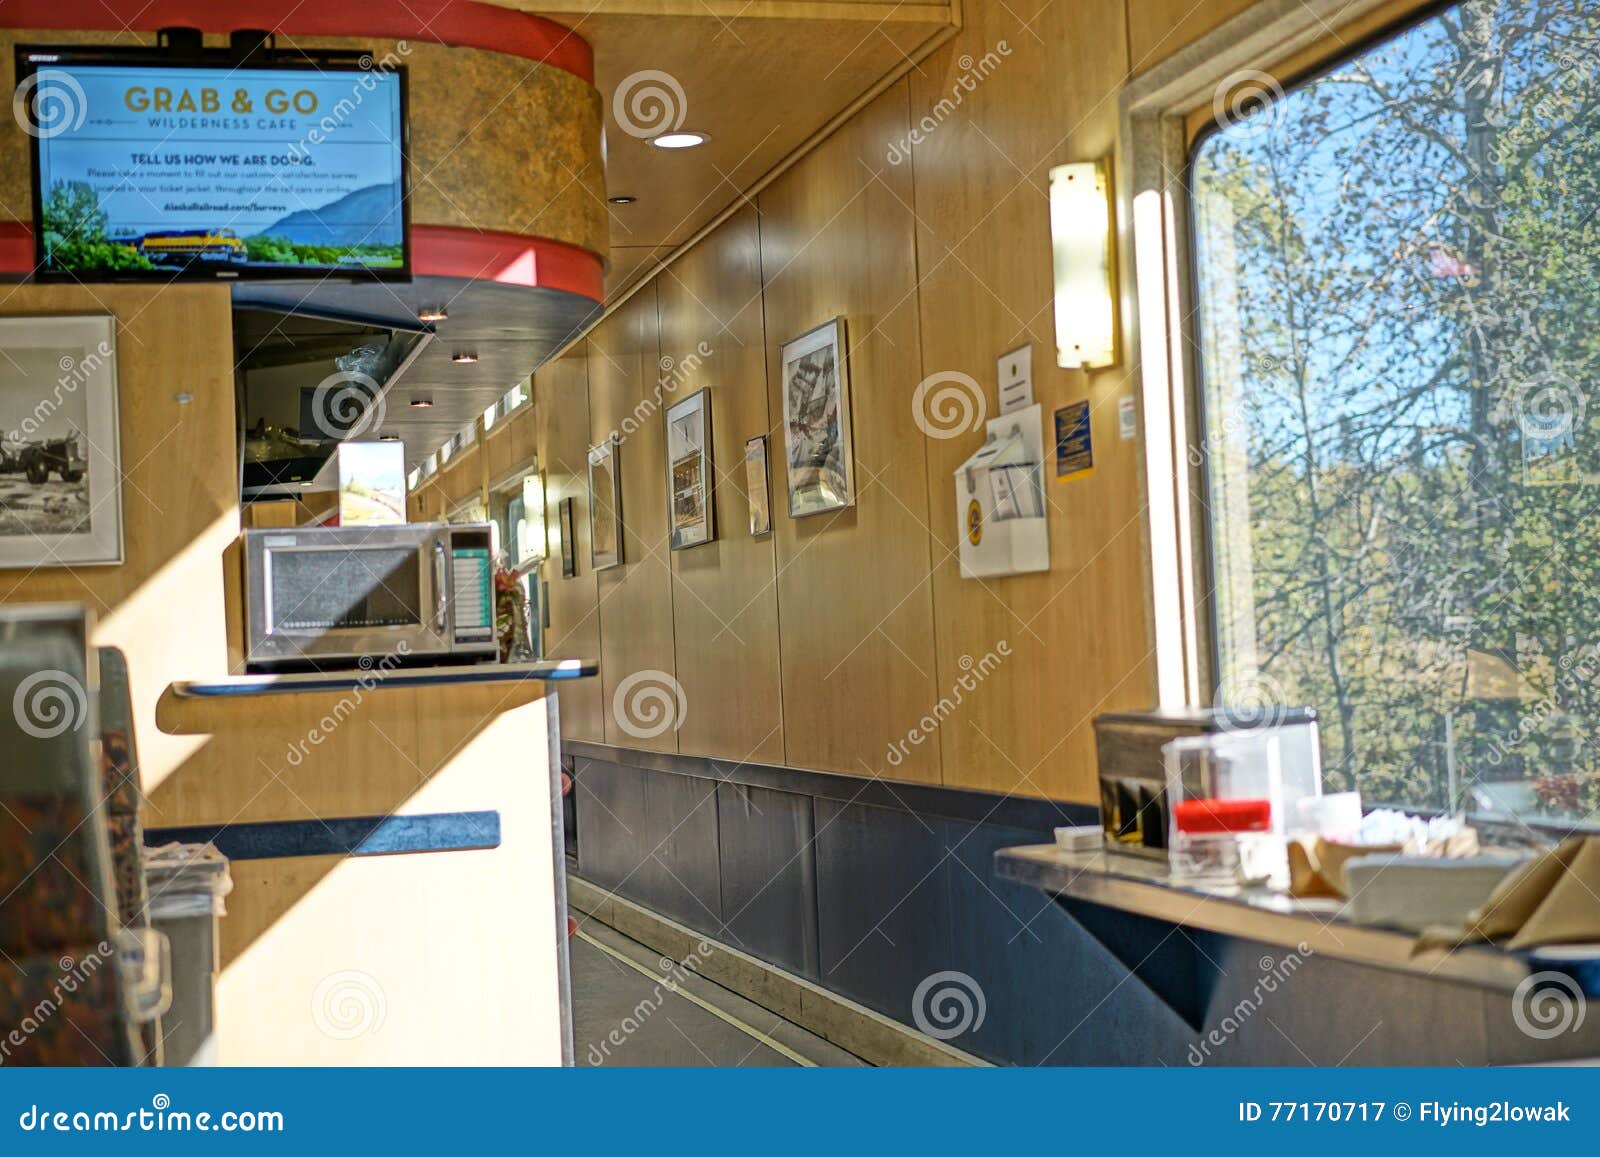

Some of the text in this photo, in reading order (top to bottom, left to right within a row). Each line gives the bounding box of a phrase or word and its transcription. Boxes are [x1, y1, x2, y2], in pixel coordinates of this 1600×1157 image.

[124, 86, 319, 115] GRAB & GO
[148, 117, 250, 129] WILDERNESS
[130, 153, 162, 165] TELL
[164, 153, 181, 165] US
[184, 154, 217, 165] HOW
[219, 155, 240, 166] WE
[243, 155, 268, 166] ARE
